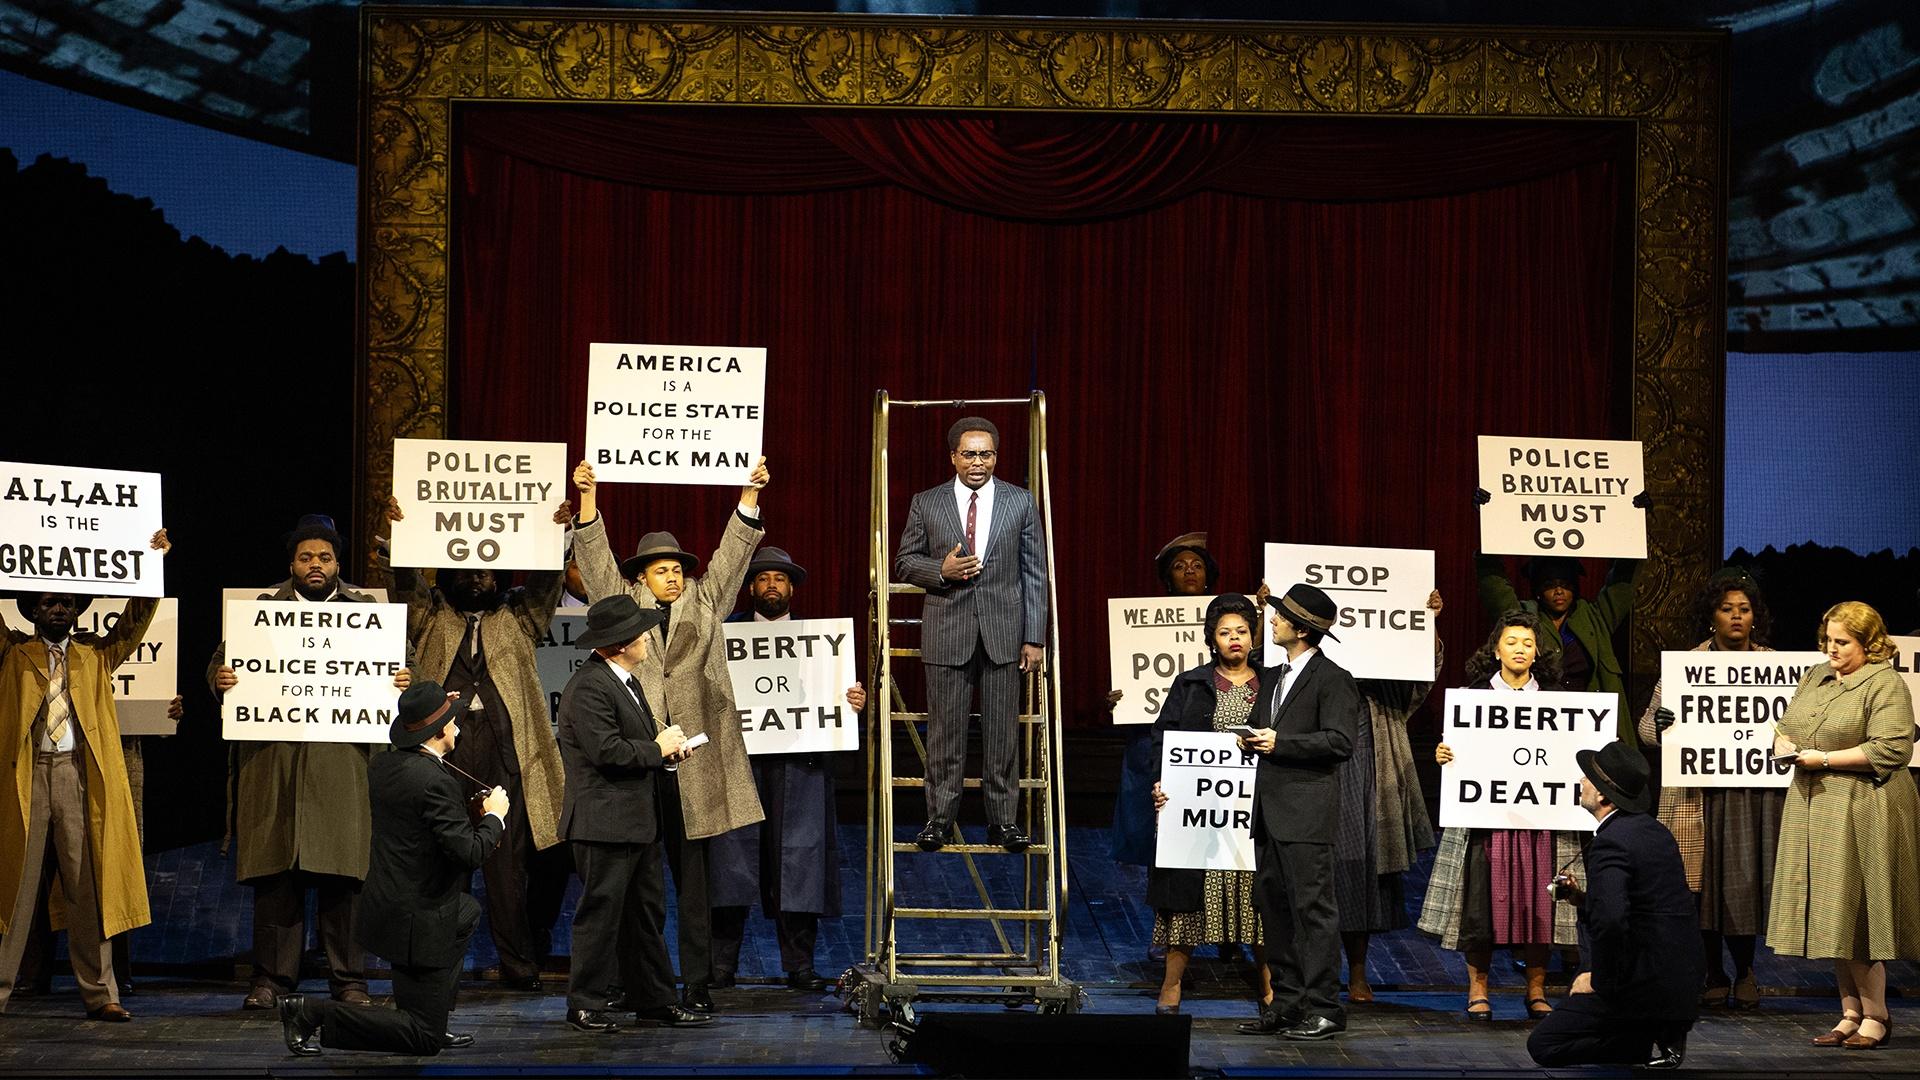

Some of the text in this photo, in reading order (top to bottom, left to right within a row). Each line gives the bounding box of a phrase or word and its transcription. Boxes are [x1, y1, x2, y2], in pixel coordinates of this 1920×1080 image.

[616, 353, 742, 373] AMERICA
[663, 380, 692, 392] IS A
[593, 401, 759, 420] POLICE STATE
[642, 427, 712, 441] FOR THE
[427, 451, 532, 475] POLICE
[597, 448, 749, 468] BLACK MAN
[1509, 447, 1610, 470] POLICE
[3, 476, 139, 509] ALLAH
[417, 479, 553, 502] BRUTALITY
[1501, 473, 1630, 496] BRUTALITY
[40, 514, 100, 532] IS THE
[435, 511, 525, 534] MUST
[1520, 503, 1607, 524] MUST
[1533, 527, 1585, 551] GO
[446, 537, 501, 563] GO
[0, 543, 145, 580] GREATEST
[1305, 563, 1390, 586] STOP
[253, 609, 383, 630] AMERICA
[1123, 608, 1149, 625] WE
[1154, 607, 1186, 624] ARE
[1334, 607, 1426, 631] STICE
[302, 636, 332, 649] IS A
[1175, 630, 1196, 643] IN
[726, 633, 846, 661] BERTY
[231, 659, 400, 676] POLICE STATE
[1684, 665, 1811, 685] WE DEMAN
[281, 684, 352, 698] FOR THE
[754, 675, 791, 694] OR
[235, 705, 391, 725] BLACK MAN
[1453, 704, 1611, 732] LIBERTY
[1680, 694, 1793, 723] FREEDO
[1733, 729, 1754, 741] OF
[1169, 747, 1232, 765] STOP
[1513, 747, 1548, 766] OR
